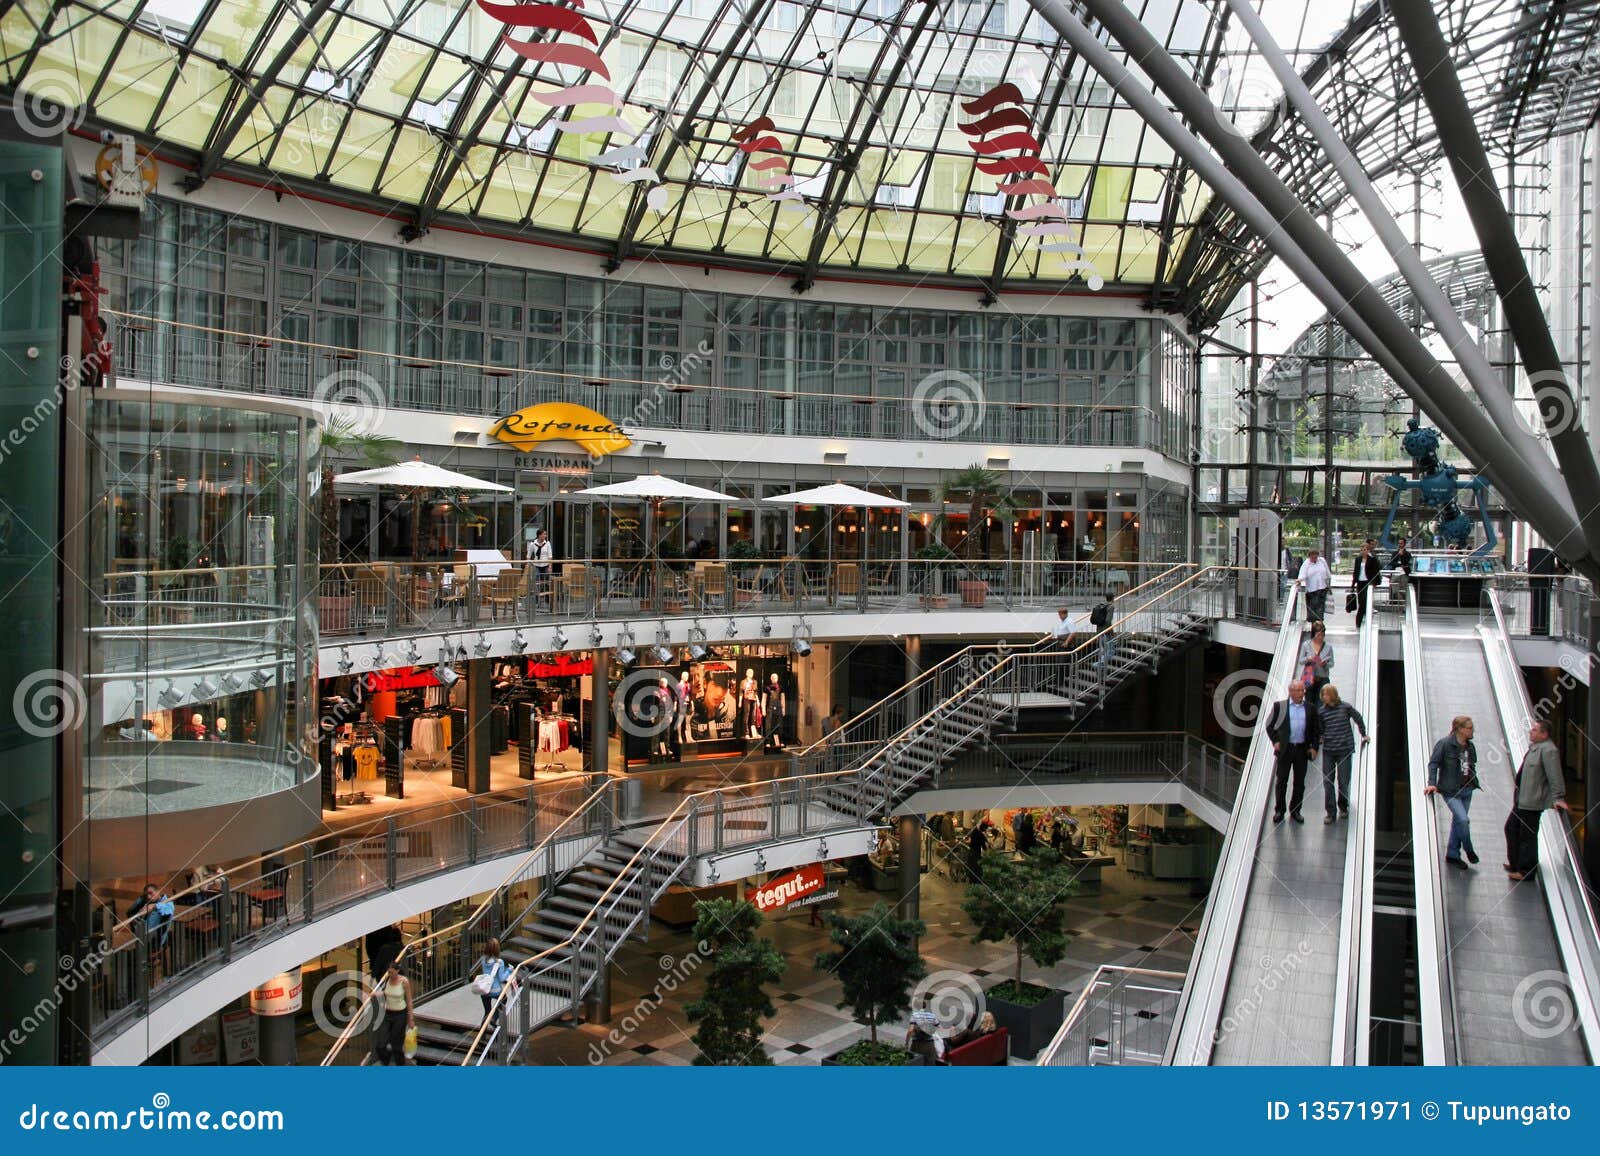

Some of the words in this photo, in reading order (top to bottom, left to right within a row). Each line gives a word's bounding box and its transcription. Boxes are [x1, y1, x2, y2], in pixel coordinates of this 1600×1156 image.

[494, 414, 633, 437] Rotonda
[514, 456, 596, 471] RESTAURANT
[756, 873, 819, 909] tegut...
